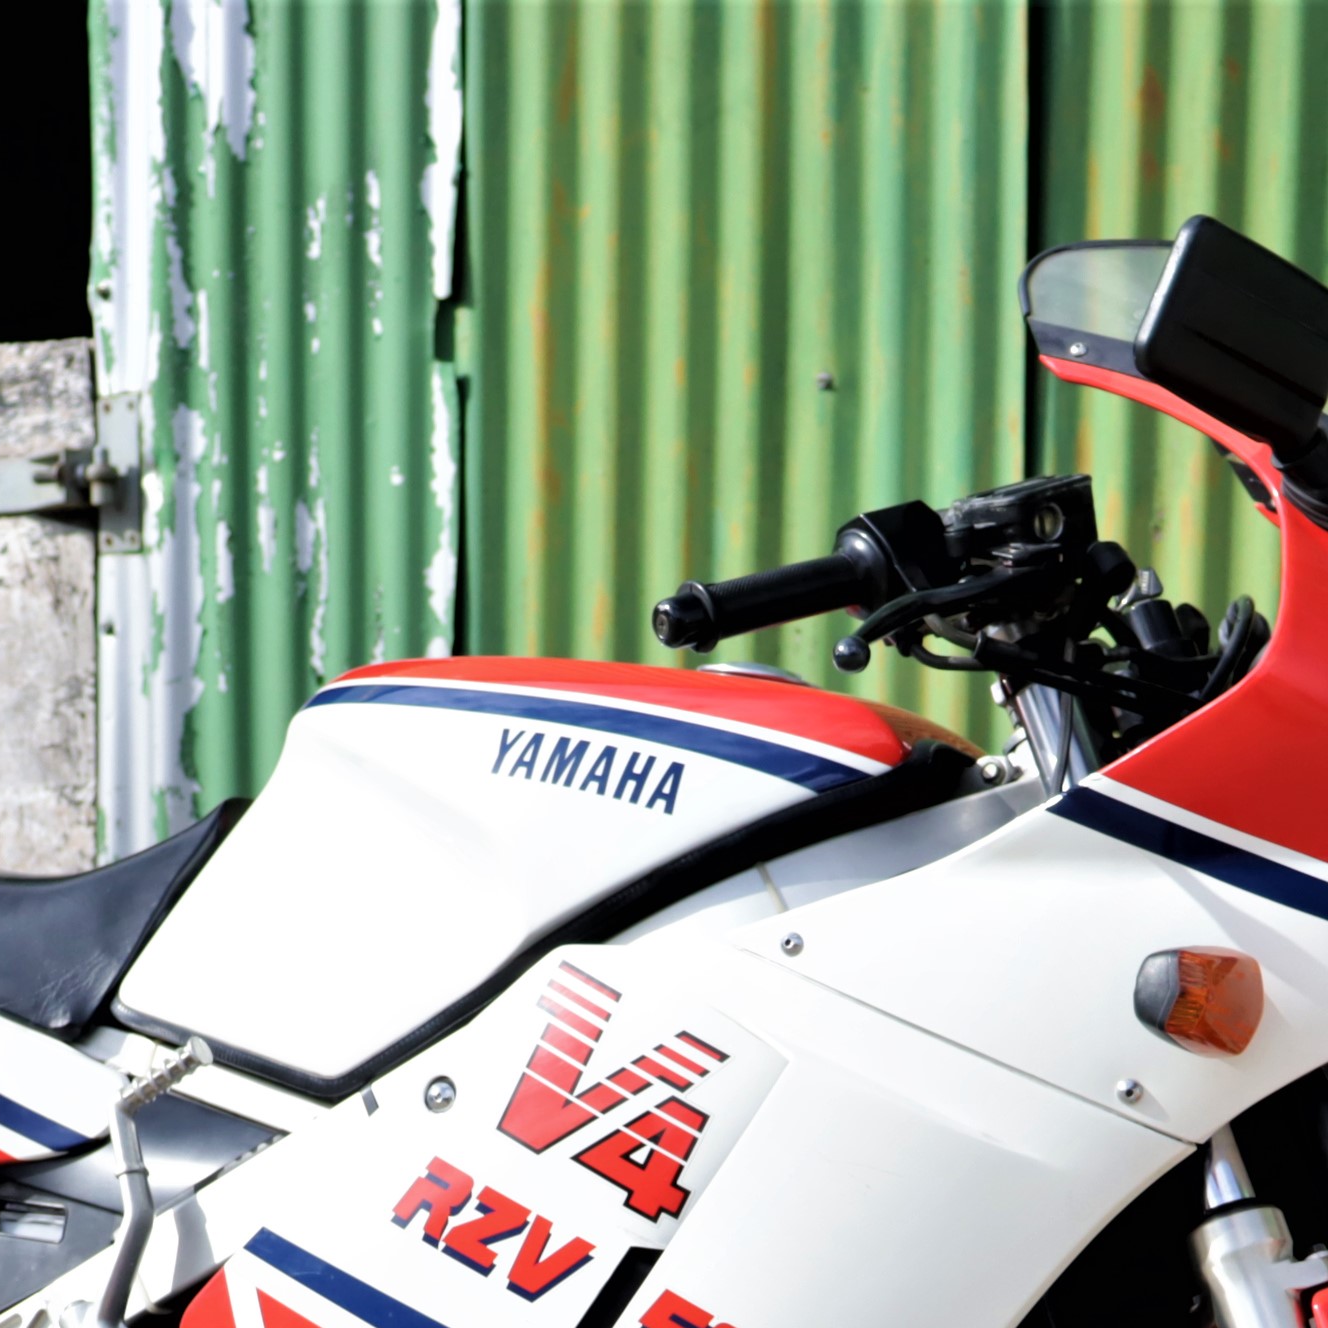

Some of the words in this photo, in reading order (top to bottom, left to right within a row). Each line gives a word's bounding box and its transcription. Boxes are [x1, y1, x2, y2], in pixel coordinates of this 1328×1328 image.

[491, 729, 686, 815] YAMAHA
[496, 959, 731, 1224] V4
[391, 1156, 596, 1302] RZV
